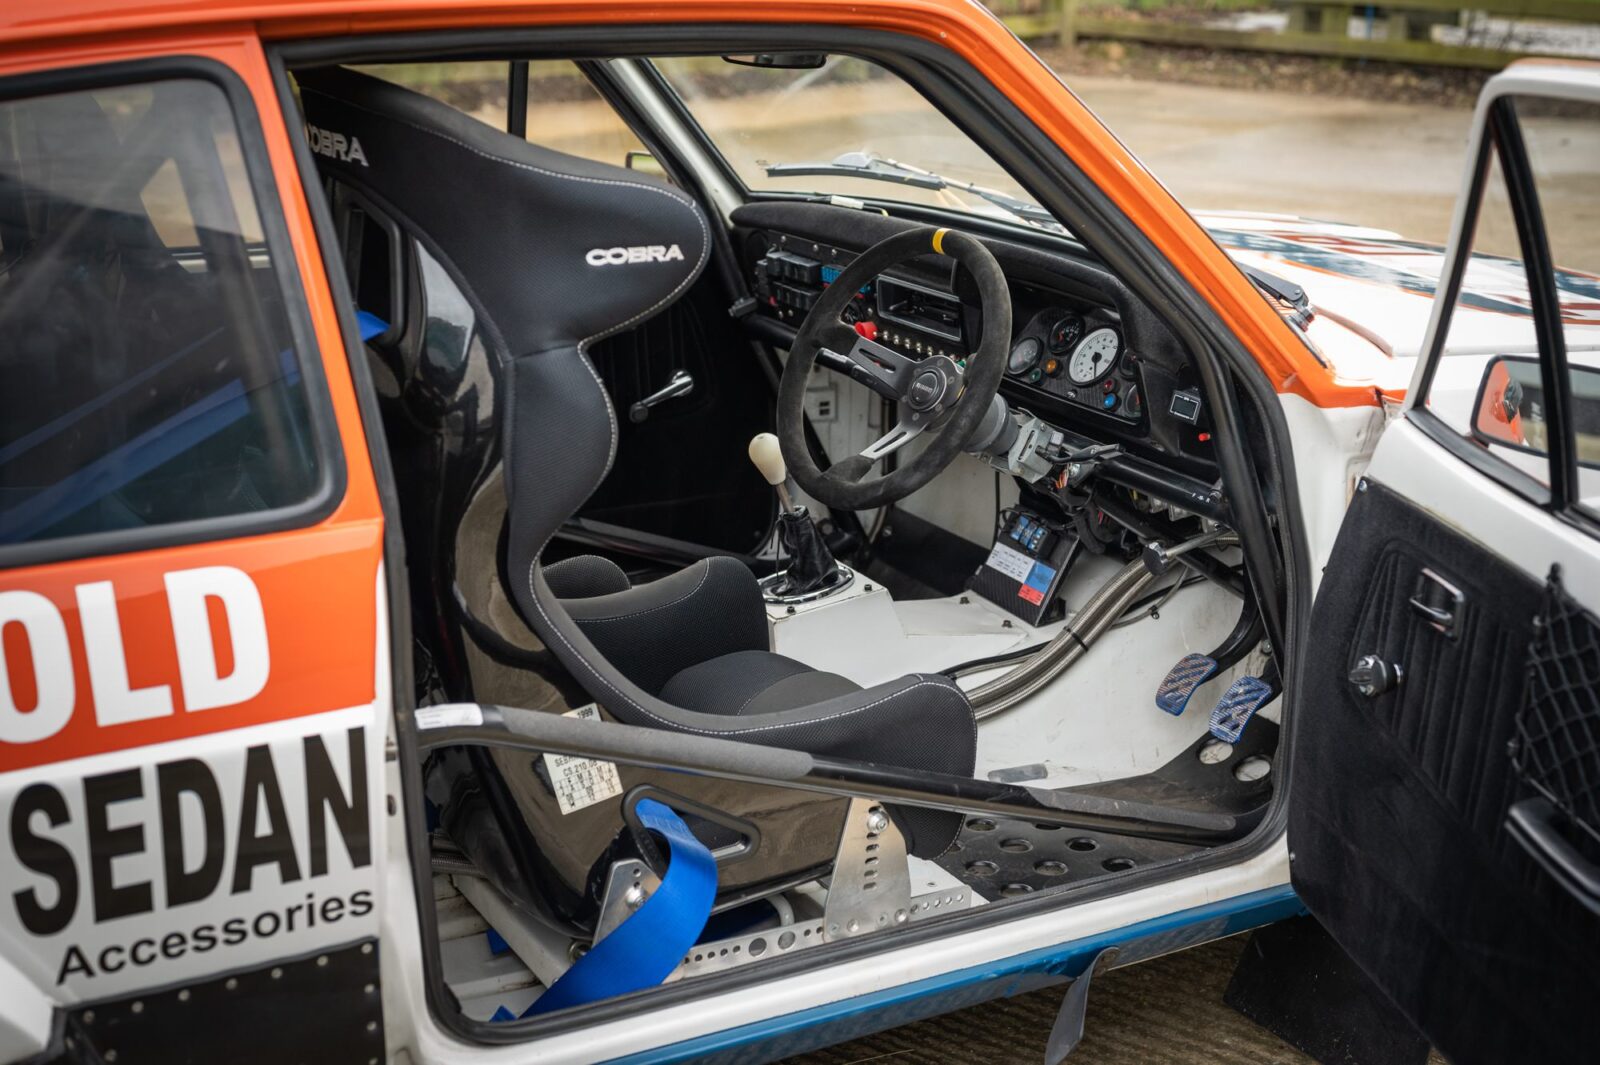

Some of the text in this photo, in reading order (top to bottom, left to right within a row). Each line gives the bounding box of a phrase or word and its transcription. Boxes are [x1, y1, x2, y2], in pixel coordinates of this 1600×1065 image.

[585, 244, 684, 266] COBRA
[0, 565, 271, 745] OLD
[9, 726, 373, 937] SEDAN
[56, 888, 375, 986] Accessories
